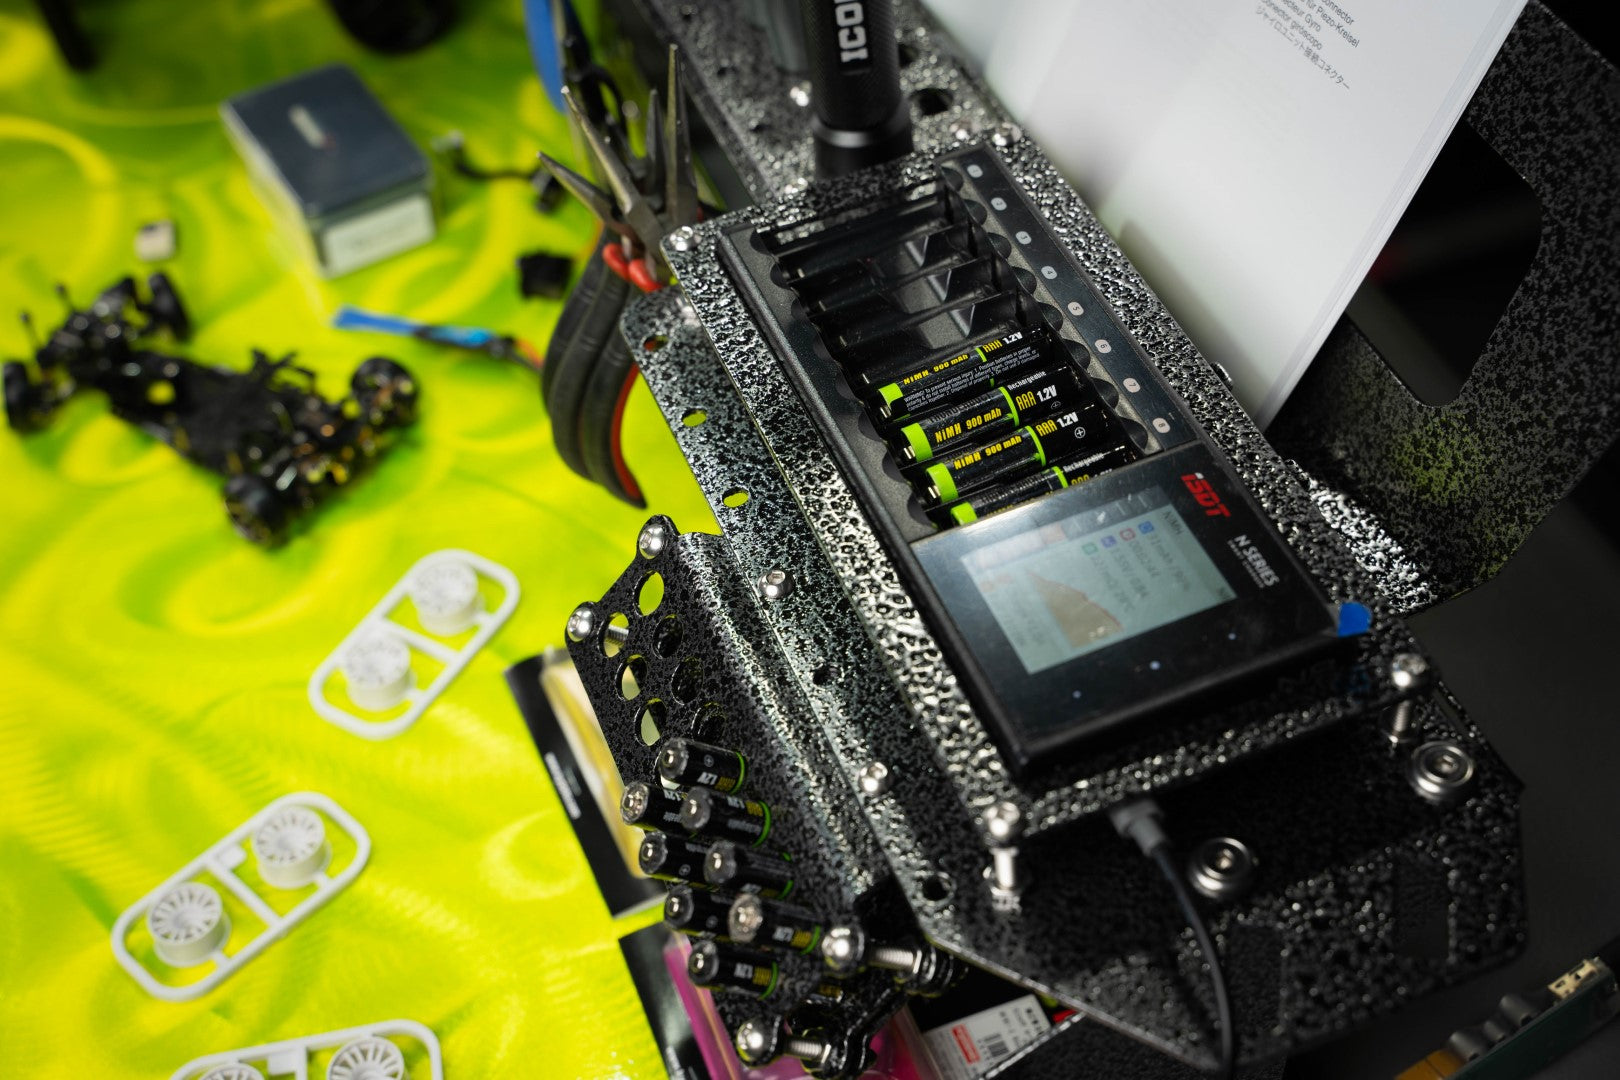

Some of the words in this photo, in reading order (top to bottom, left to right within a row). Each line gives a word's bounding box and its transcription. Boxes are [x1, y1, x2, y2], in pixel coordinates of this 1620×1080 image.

[1304, 13, 1322, 32] Gyro
[1321, 0, 1355, 26] onnector
[834, 0, 868, 63] ICO
[1316, 6, 1360, 48] Piezo-Kreisel
[1002, 331, 1023, 345] 1.2V
[1015, 391, 1037, 411] AAA
[1036, 384, 1058, 402] 1.2V
[934, 422, 962, 443] NiMH
[965, 415, 983, 430] 900
[983, 407, 1003, 423] mAh
[1035, 419, 1058, 437] AAA
[1056, 411, 1079, 428] 1.2V
[953, 451, 982, 470] NiMH
[984, 443, 1003, 457] 900
[1002, 435, 1022, 449] mAh
[1233, 534, 1252, 548] N
[1242, 545, 1280, 587] SERIES
